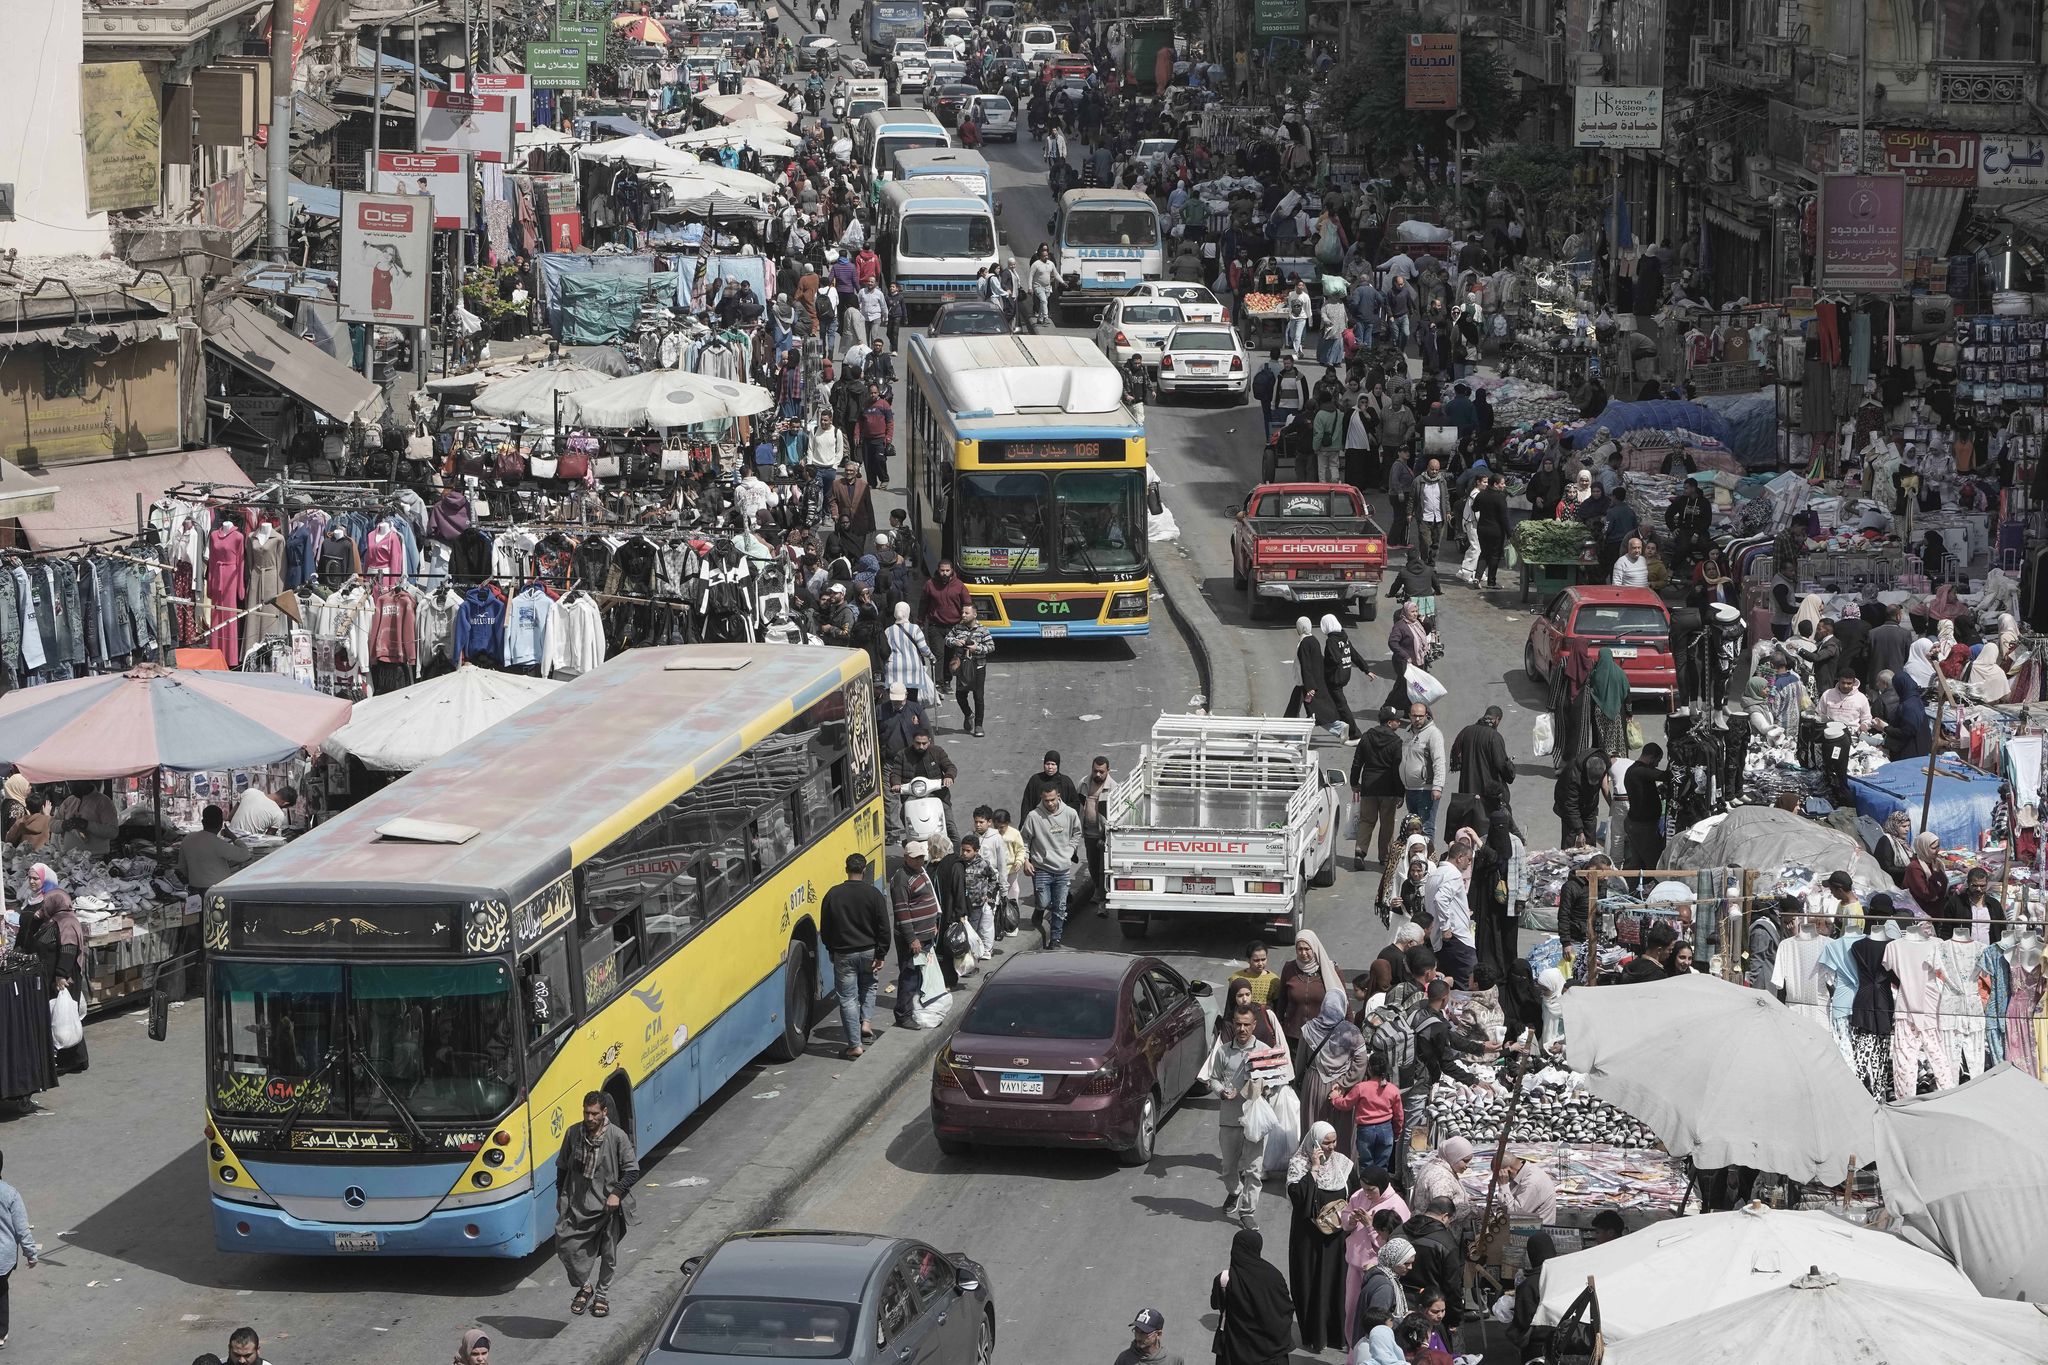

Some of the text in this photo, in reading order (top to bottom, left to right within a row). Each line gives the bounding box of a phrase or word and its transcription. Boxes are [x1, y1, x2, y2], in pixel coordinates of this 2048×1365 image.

[1410, 54, 1454, 69] المدينة
[446, 95, 484, 106] Ots
[1578, 119, 1658, 132] حمادة صديق
[1888, 134, 1930, 149] ماركت
[392, 156, 436, 167] Ots
[1890, 140, 1975, 175] الطيب
[364, 210, 408, 222] Ots
[1830, 225, 1896, 236] عبد الموجود
[1078, 248, 1144, 258] HASSAAN
[1008, 443, 1100, 458] 1068 ميدان لبنان
[1282, 544, 1358, 553] CHEVROLET
[1037, 602, 1070, 614] CTA
[1144, 840, 1249, 854] CHEVROLET
[790, 886, 805, 910] 8172
[645, 1016, 662, 1042] CTA
[268, 1083, 295, 1099] ١٠٦٨
[1001, 1083, 1020, 1094] ٧٨٧١
[361, 1134, 378, 1149] يسر
[380, 1134, 398, 1149] رب
